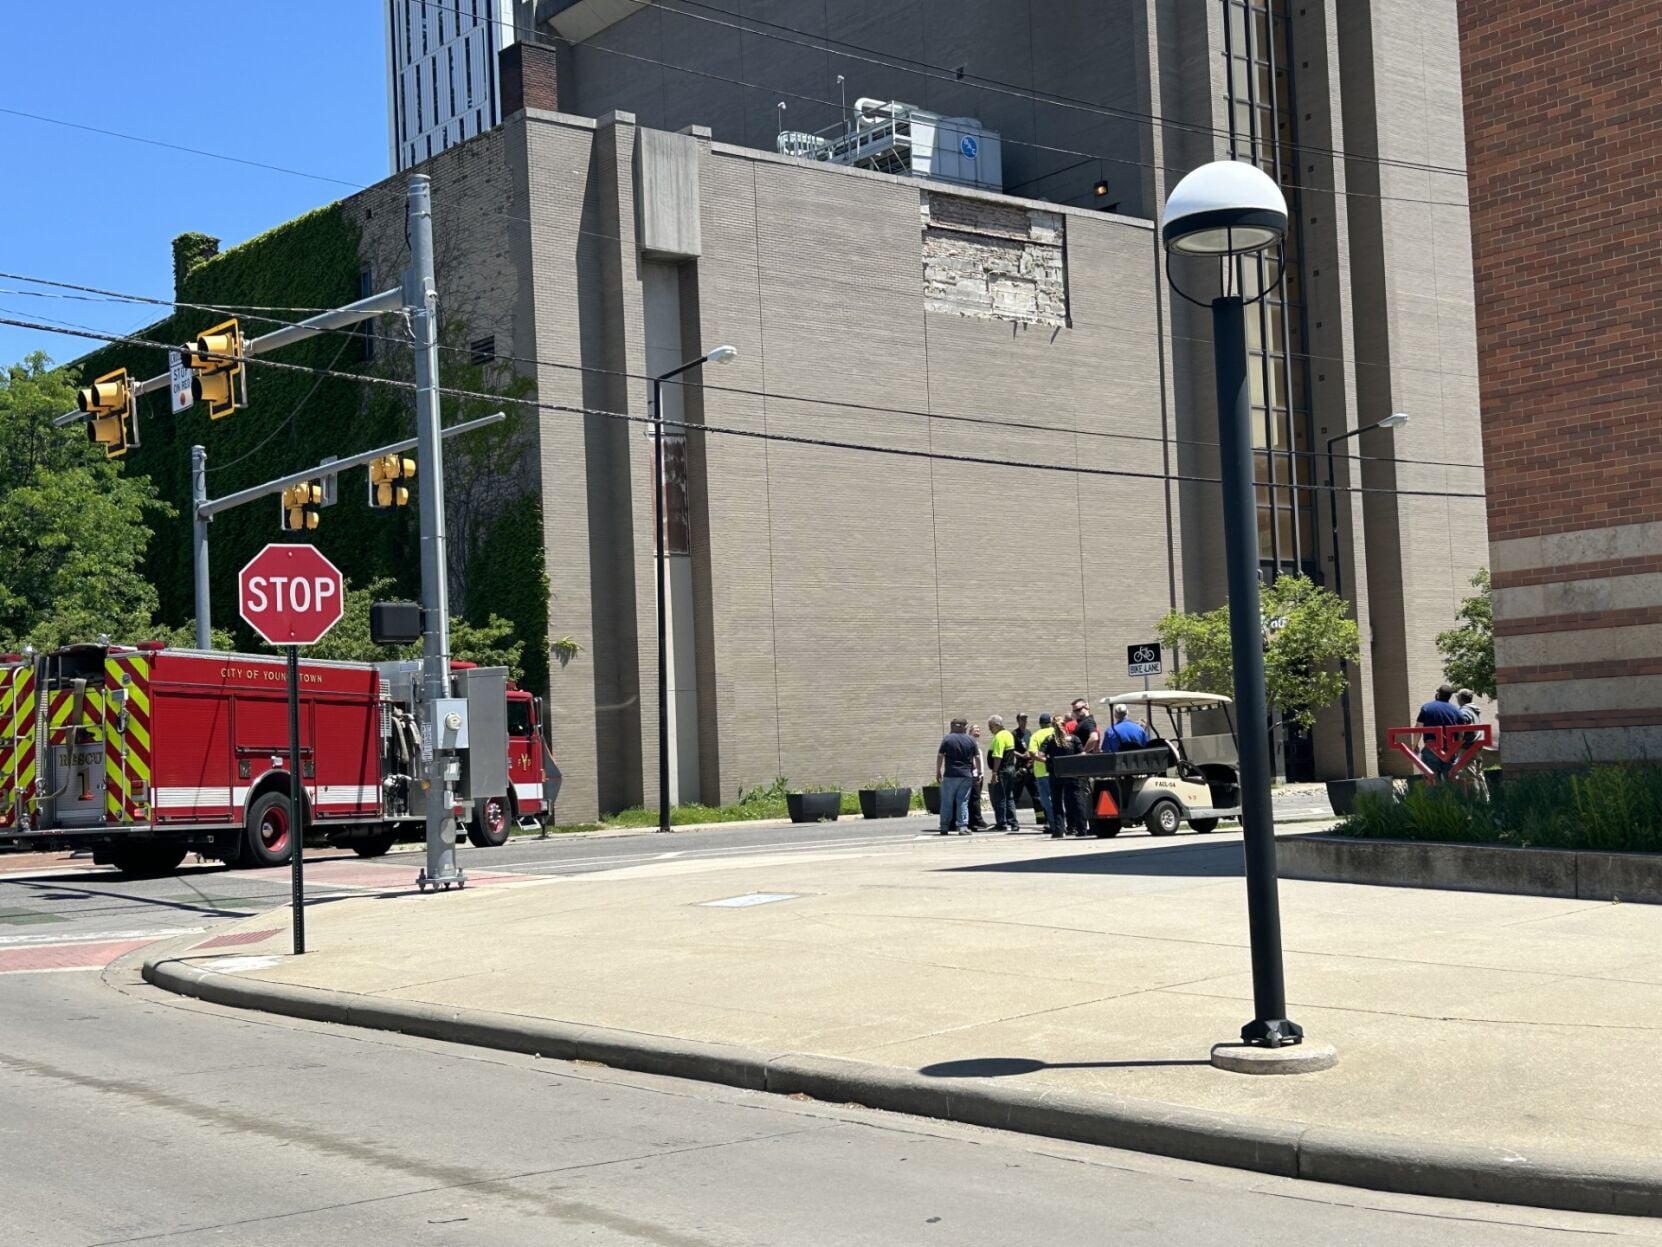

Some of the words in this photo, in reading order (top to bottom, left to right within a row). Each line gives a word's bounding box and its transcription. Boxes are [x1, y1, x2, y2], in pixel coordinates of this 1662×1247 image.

[173, 383, 181, 394] ON
[181, 378, 191, 391] RED
[247, 575, 336, 613] STOP
[220, 667, 243, 679] CITY
[246, 669, 259, 680] OF
[263, 671, 323, 684] YOUNTOWN
[1130, 664, 1143, 674] BIKE
[1144, 663, 1160, 673] LANE
[59, 752, 103, 767] RESCU
[77, 767, 96, 801] 1
